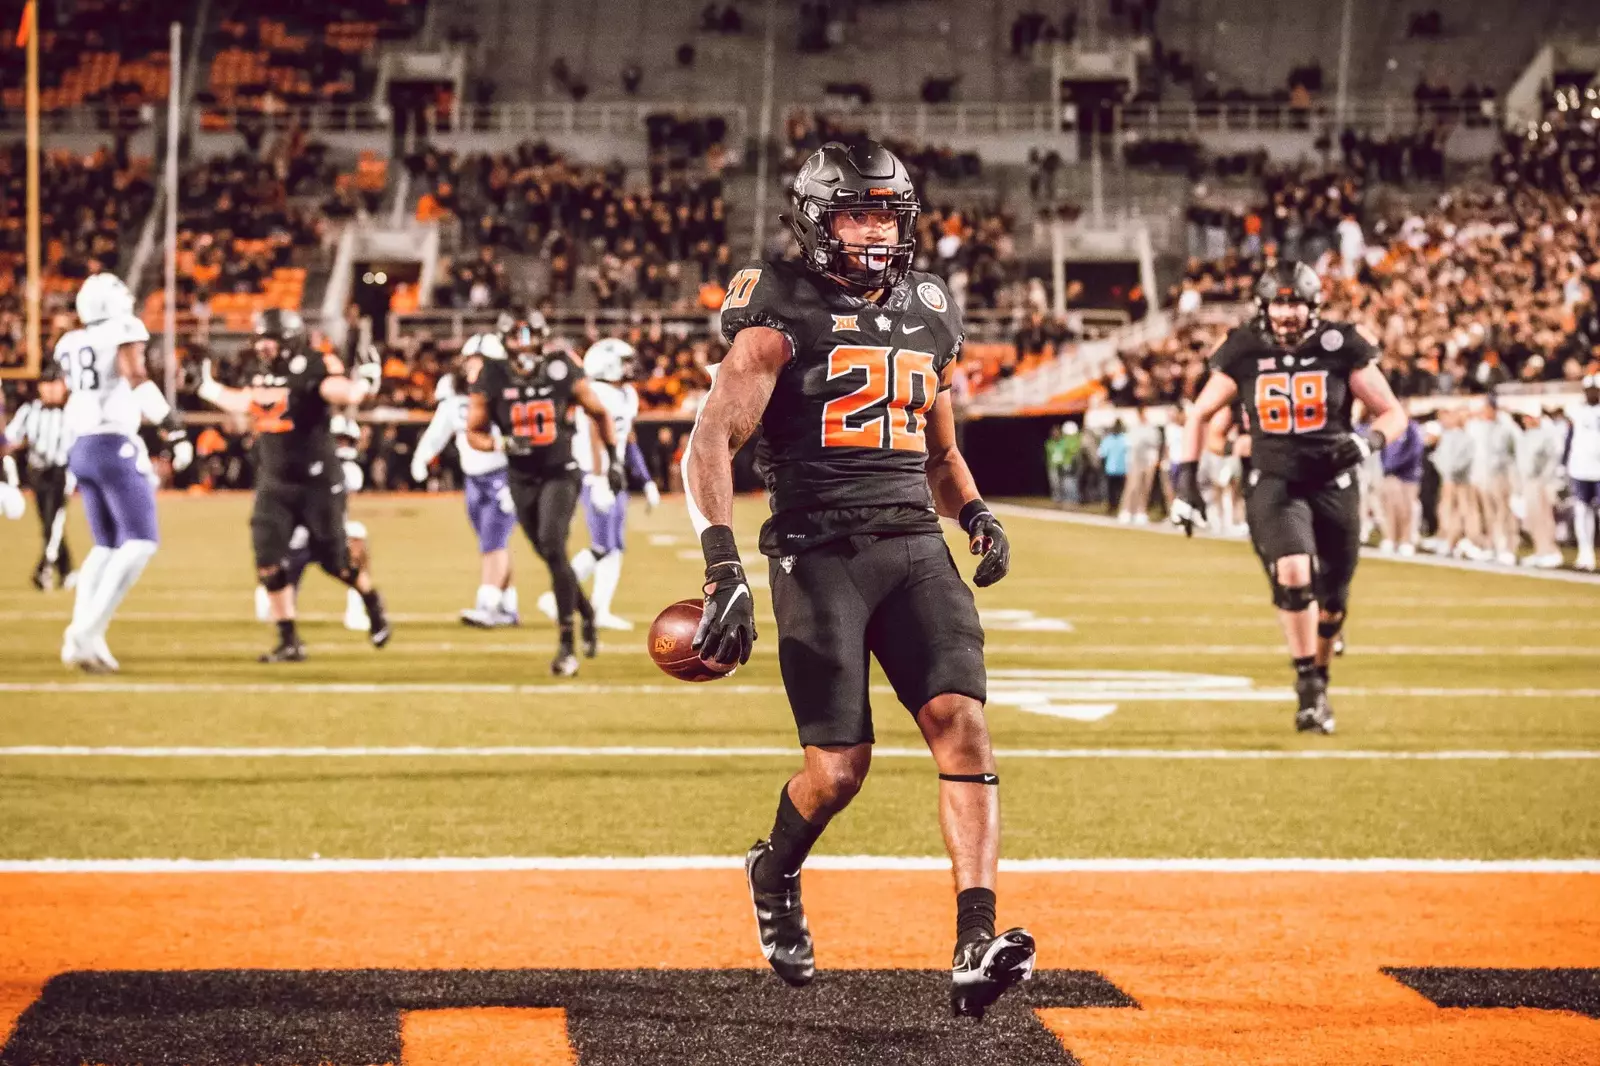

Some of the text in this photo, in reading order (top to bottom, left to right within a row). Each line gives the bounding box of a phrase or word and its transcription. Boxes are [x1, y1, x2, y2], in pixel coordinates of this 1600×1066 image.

[721, 269, 762, 314] 20
[511, 400, 556, 446] 10
[822, 345, 940, 453] 20
[1255, 370, 1328, 434] 68
